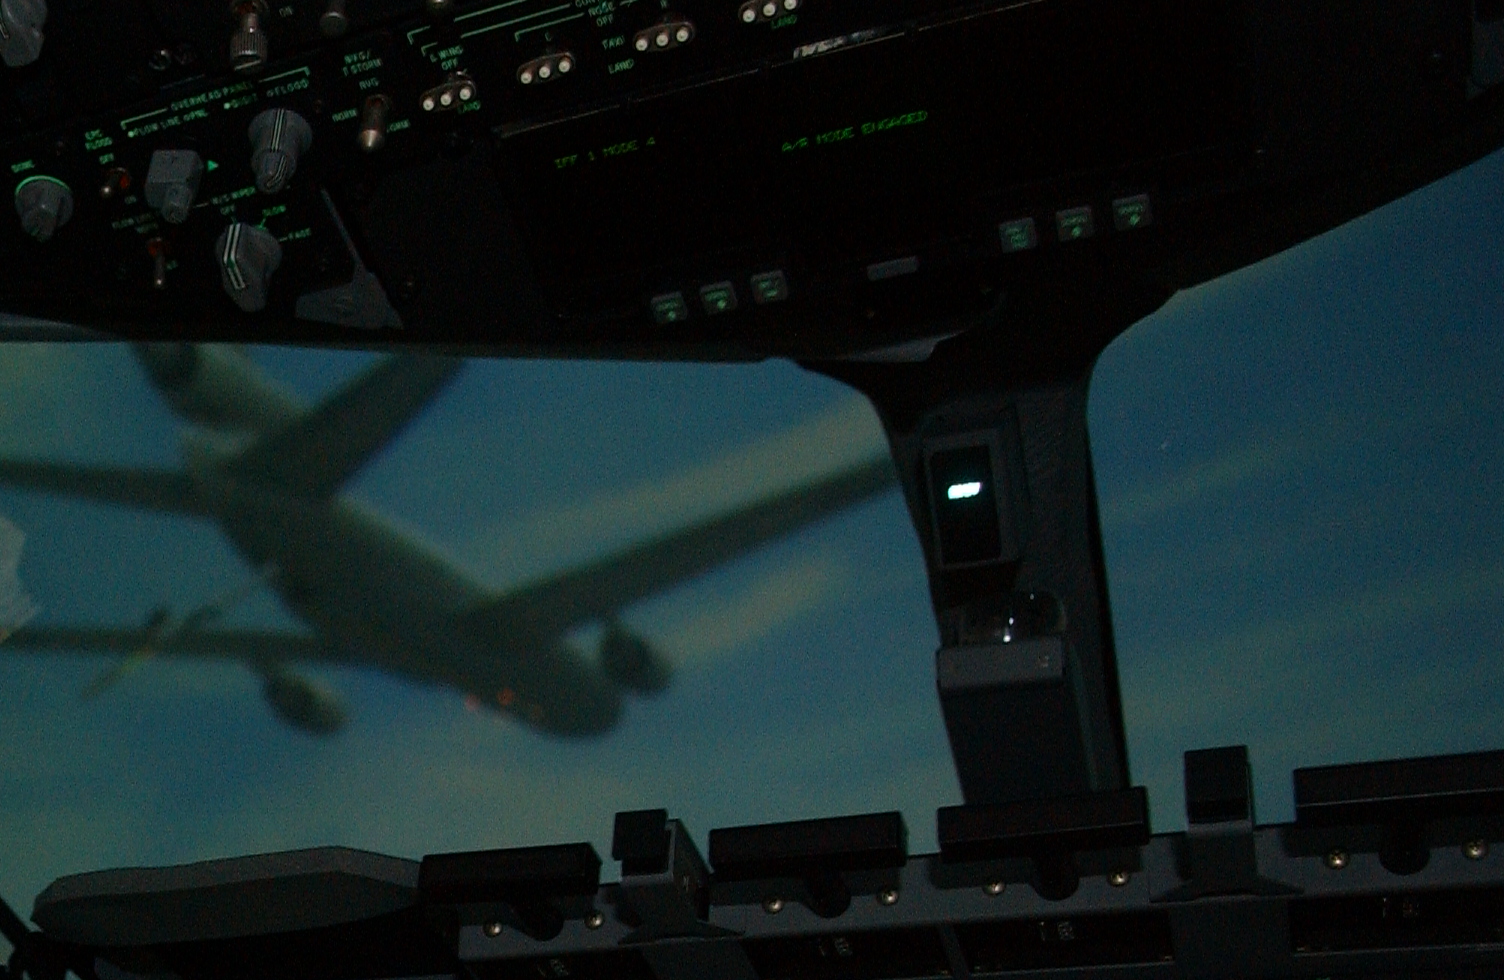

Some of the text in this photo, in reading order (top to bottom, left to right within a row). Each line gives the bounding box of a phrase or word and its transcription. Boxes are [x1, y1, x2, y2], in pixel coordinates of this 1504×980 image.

[596, 15, 614, 27] OFF
[441, 58, 459, 71] OFF
[607, 58, 635, 75] LAND
[815, 126, 855, 145] MODE
[860, 110, 928, 135] ENGAGED
[554, 155, 578, 169] IFF
[601, 139, 639, 158] MODE
